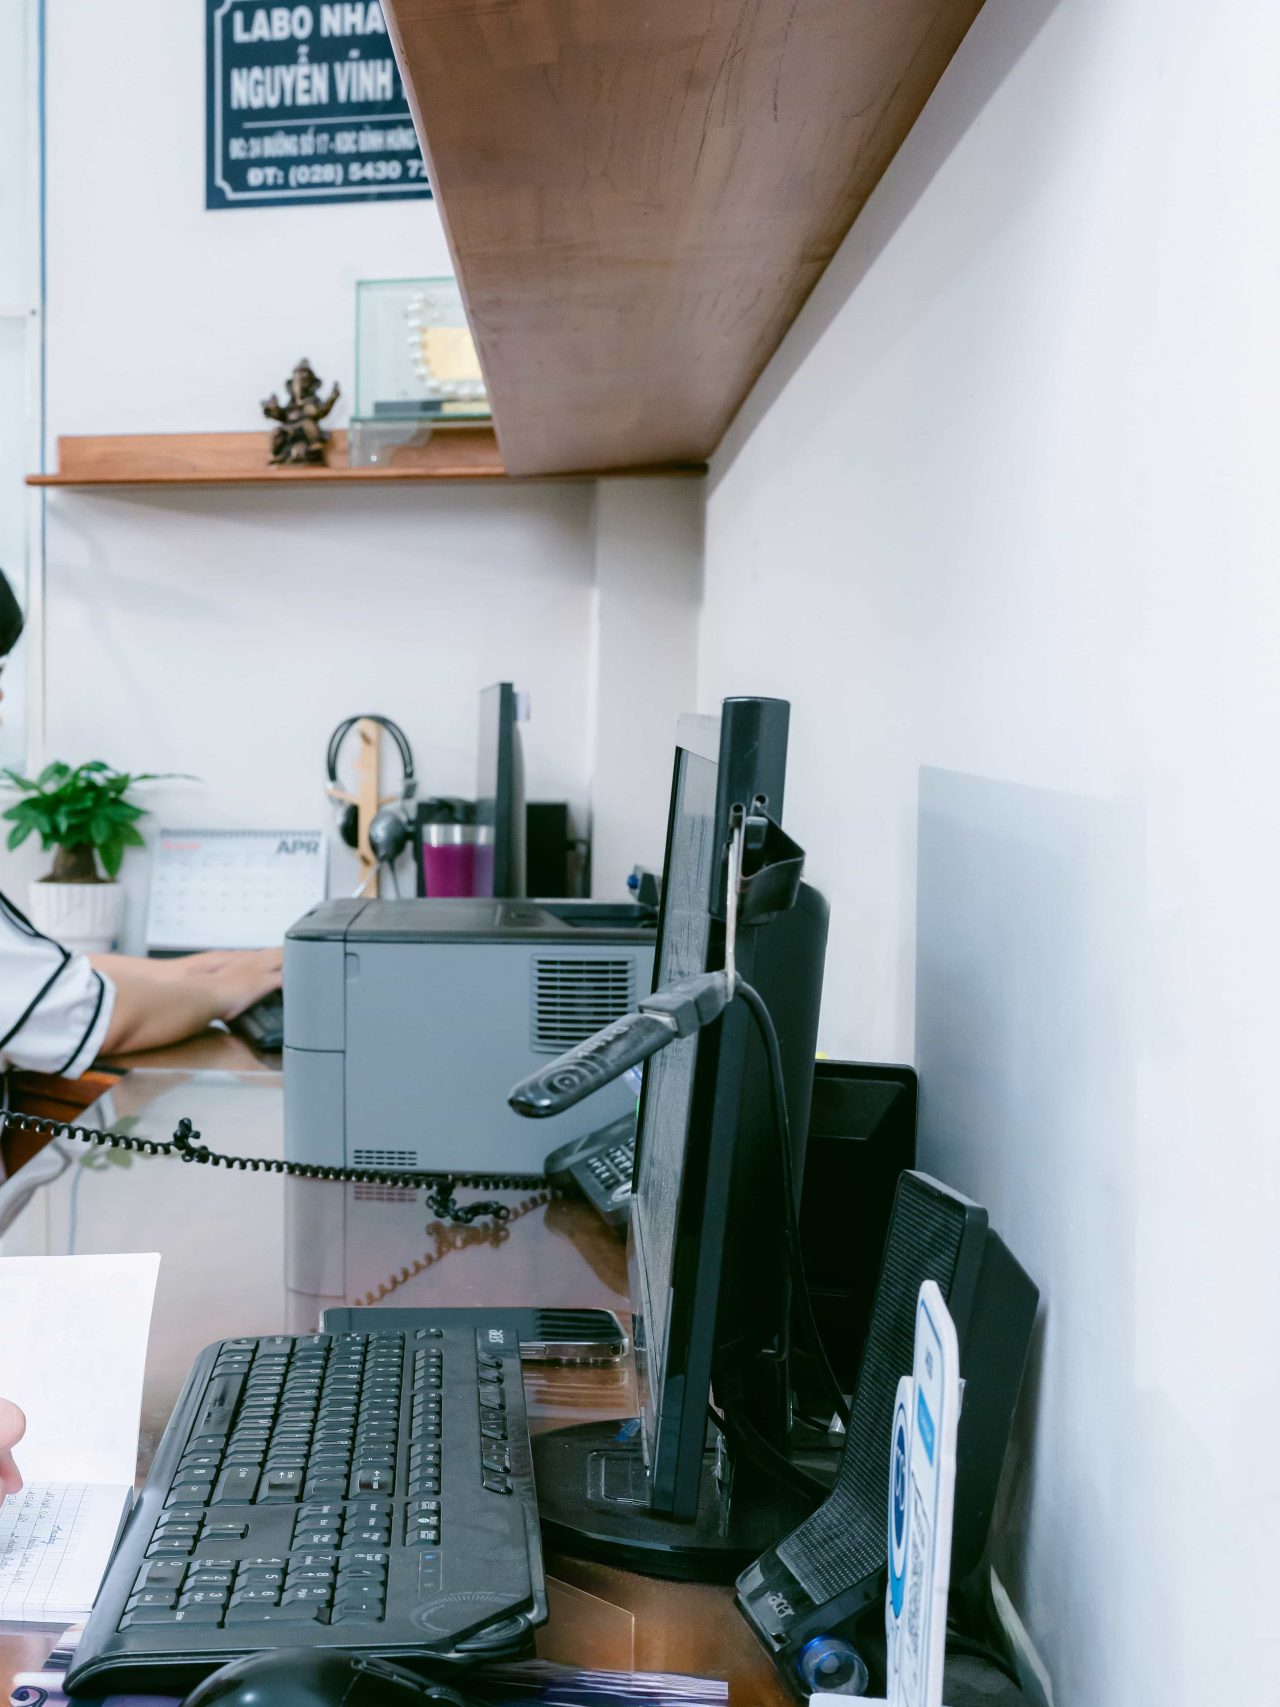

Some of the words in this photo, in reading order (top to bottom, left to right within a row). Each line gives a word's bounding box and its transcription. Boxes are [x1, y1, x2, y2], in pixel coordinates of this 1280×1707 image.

[233, 5, 314, 43] LABO
[320, 2, 387, 38] NHA
[288, 163, 344, 188] (028)
[348, 160, 402, 182] 5430
[277, 840, 319, 855] APR
[767, 1590, 795, 1618] acer
